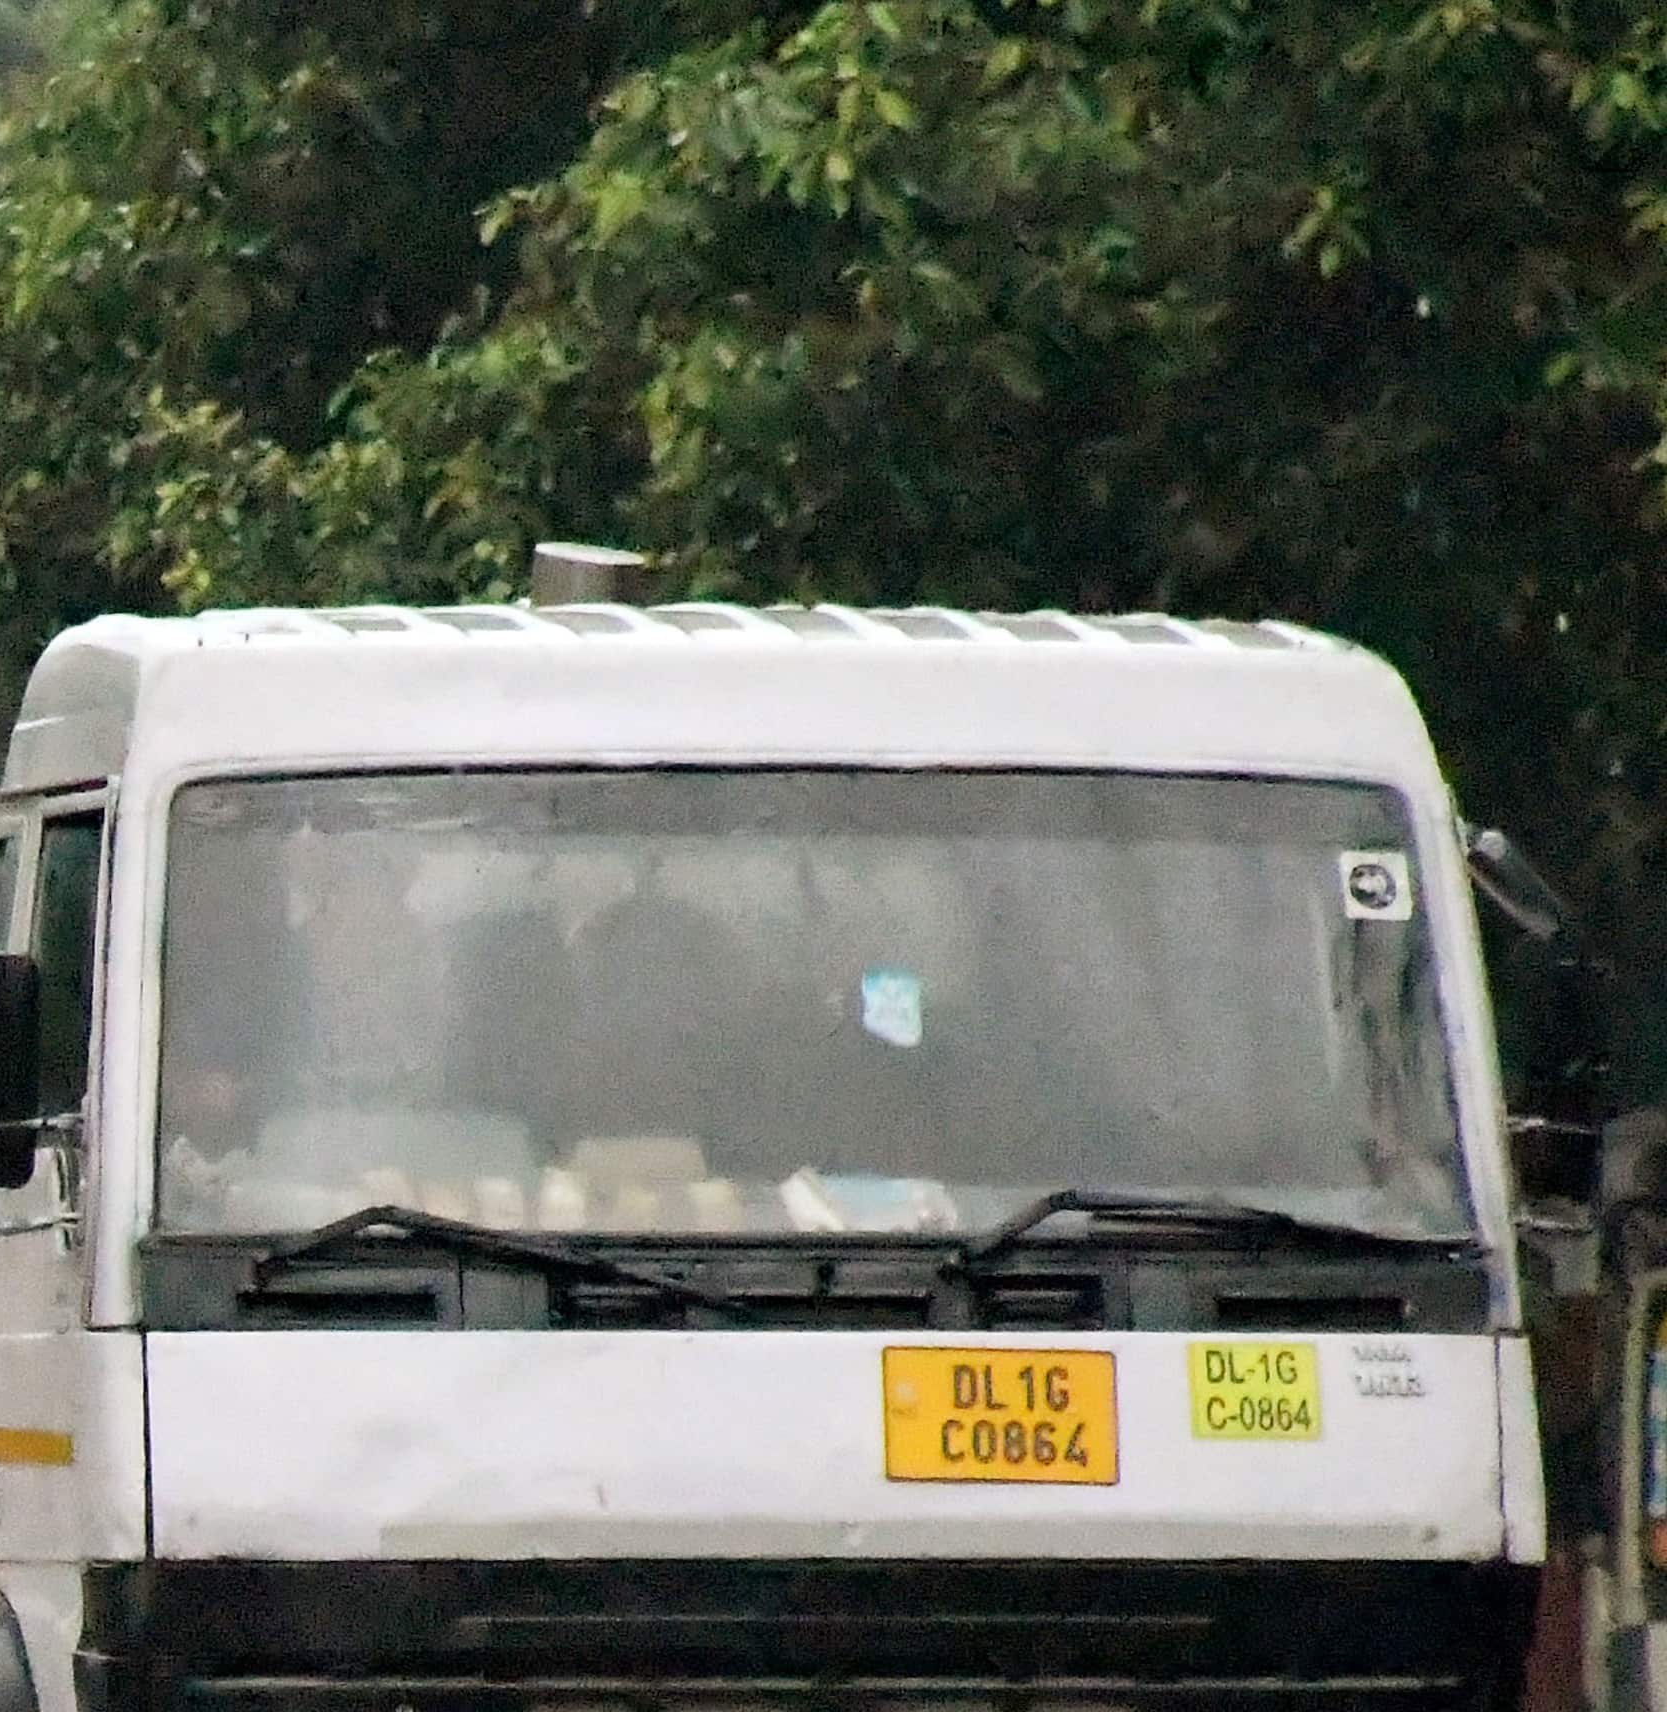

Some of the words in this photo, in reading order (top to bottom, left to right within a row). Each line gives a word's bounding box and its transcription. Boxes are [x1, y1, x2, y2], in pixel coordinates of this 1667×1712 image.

[1205, 1349, 1298, 1385] DL-1G
[1207, 1396, 1311, 1431] C-0864
[941, 1418, 1088, 1467] C0864
